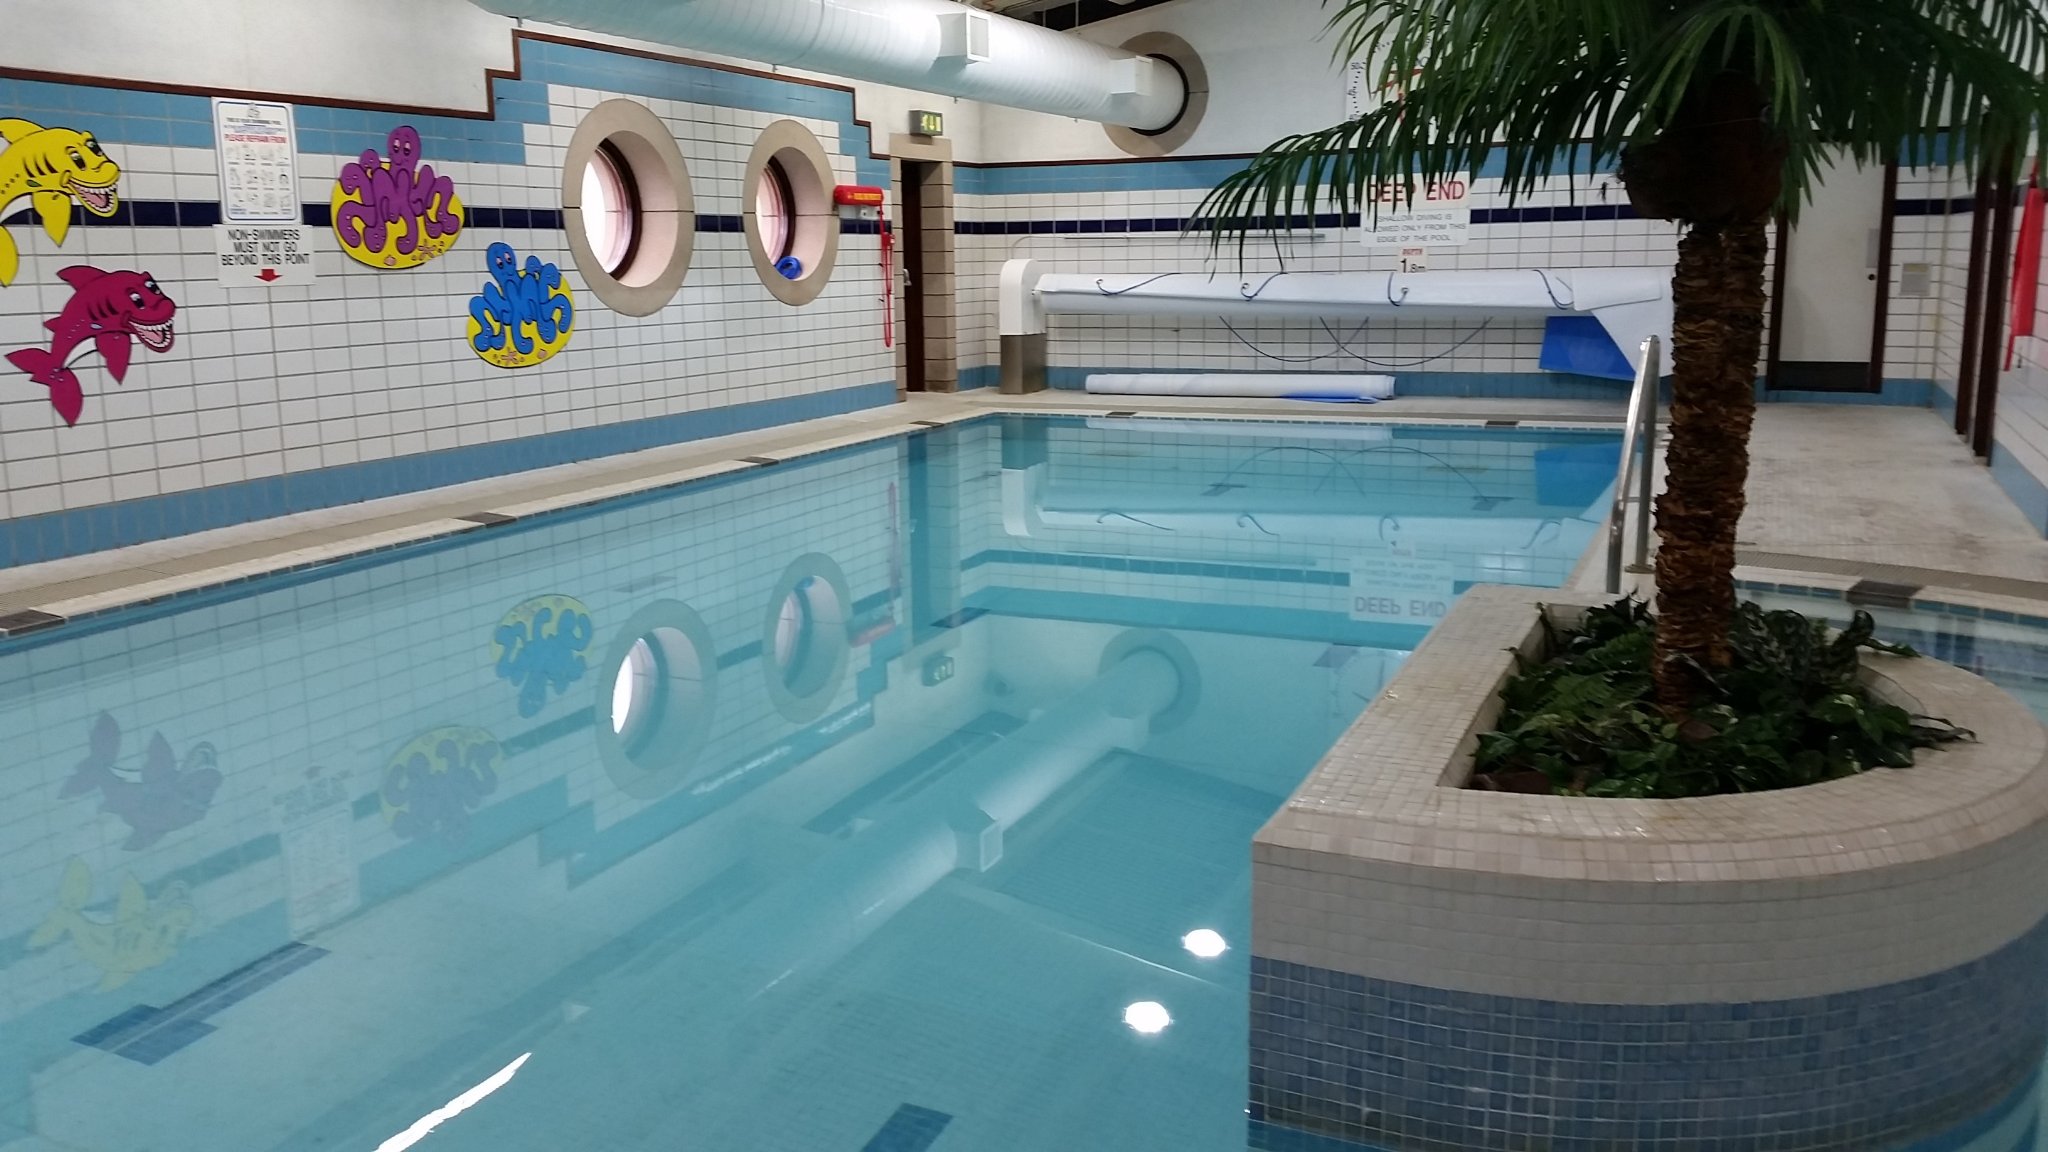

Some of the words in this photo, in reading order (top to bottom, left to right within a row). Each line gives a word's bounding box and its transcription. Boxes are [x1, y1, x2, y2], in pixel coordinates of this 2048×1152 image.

[1368, 183, 1417, 203] DEE
[1426, 180, 1465, 201] END
[1378, 214, 1413, 222] SHALLOW
[1416, 213, 1442, 221] DIVING
[1364, 225, 1400, 233] ALOWED
[1401, 224, 1421, 232] ONLY
[1424, 223, 1447, 231] FROM
[1449, 222, 1466, 230] THIS
[227, 228, 300, 241] NON-SWIMMERS
[233, 241, 259, 253] MUST
[262, 241, 280, 253] NOT
[283, 241, 298, 253] GO
[221, 254, 259, 266] BEYOND
[261, 253, 281, 265] THIS
[284, 253, 310, 264] POINT
